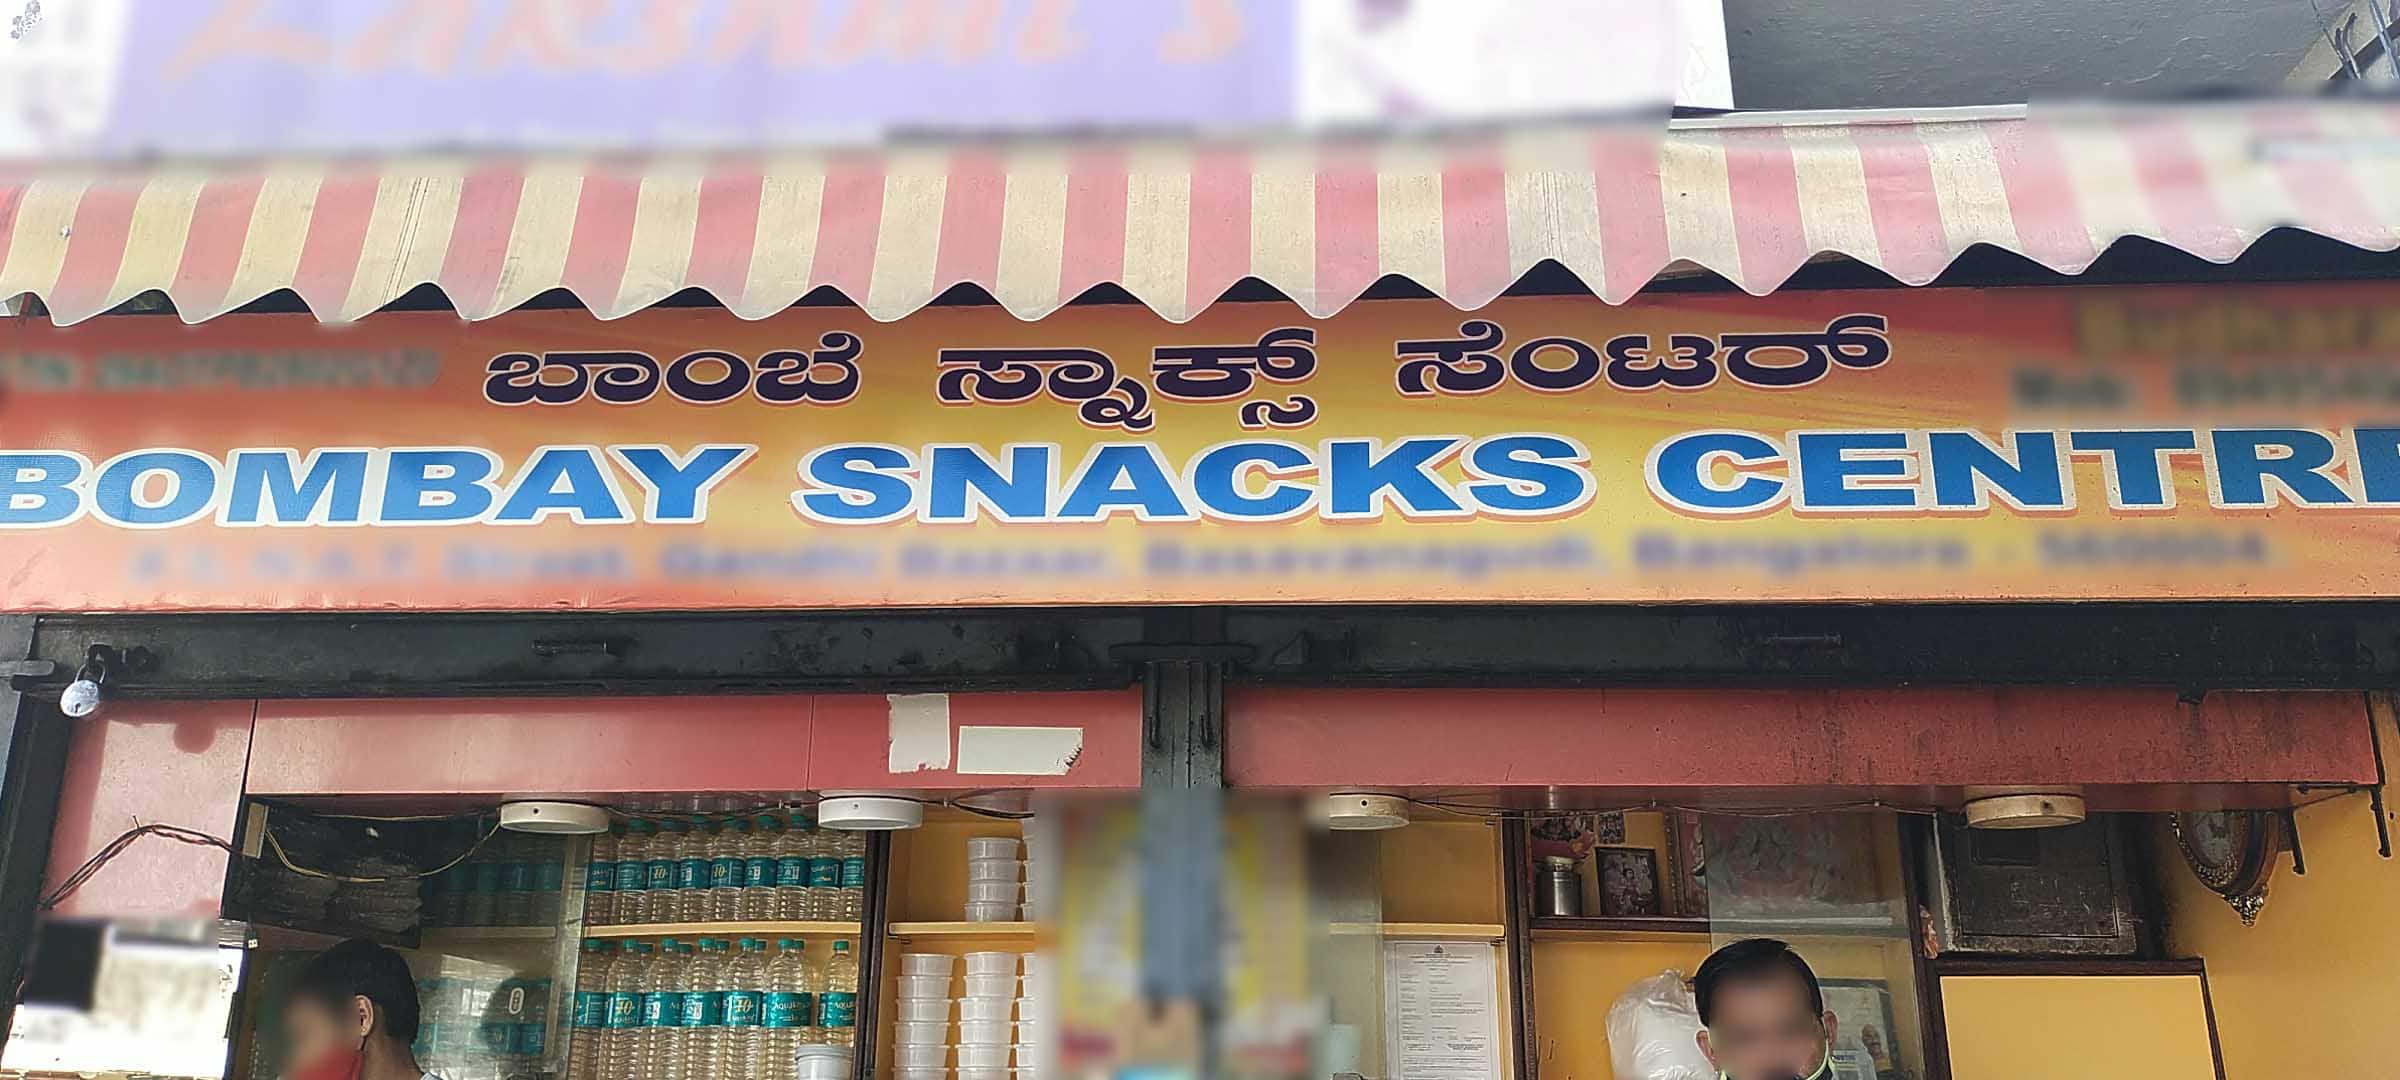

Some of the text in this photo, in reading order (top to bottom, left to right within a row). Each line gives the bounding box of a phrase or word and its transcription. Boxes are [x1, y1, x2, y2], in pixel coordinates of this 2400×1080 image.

[484, 331, 862, 405] ಬಾಂಬೆ
[936, 326, 1318, 430] ಸ್ನಾಕ್ಸ್
[1396, 313, 1891, 395] ಸೆಂಟರ್
[0, 445, 757, 528] BOMBAY
[791, 435, 1594, 523] SNACKS
